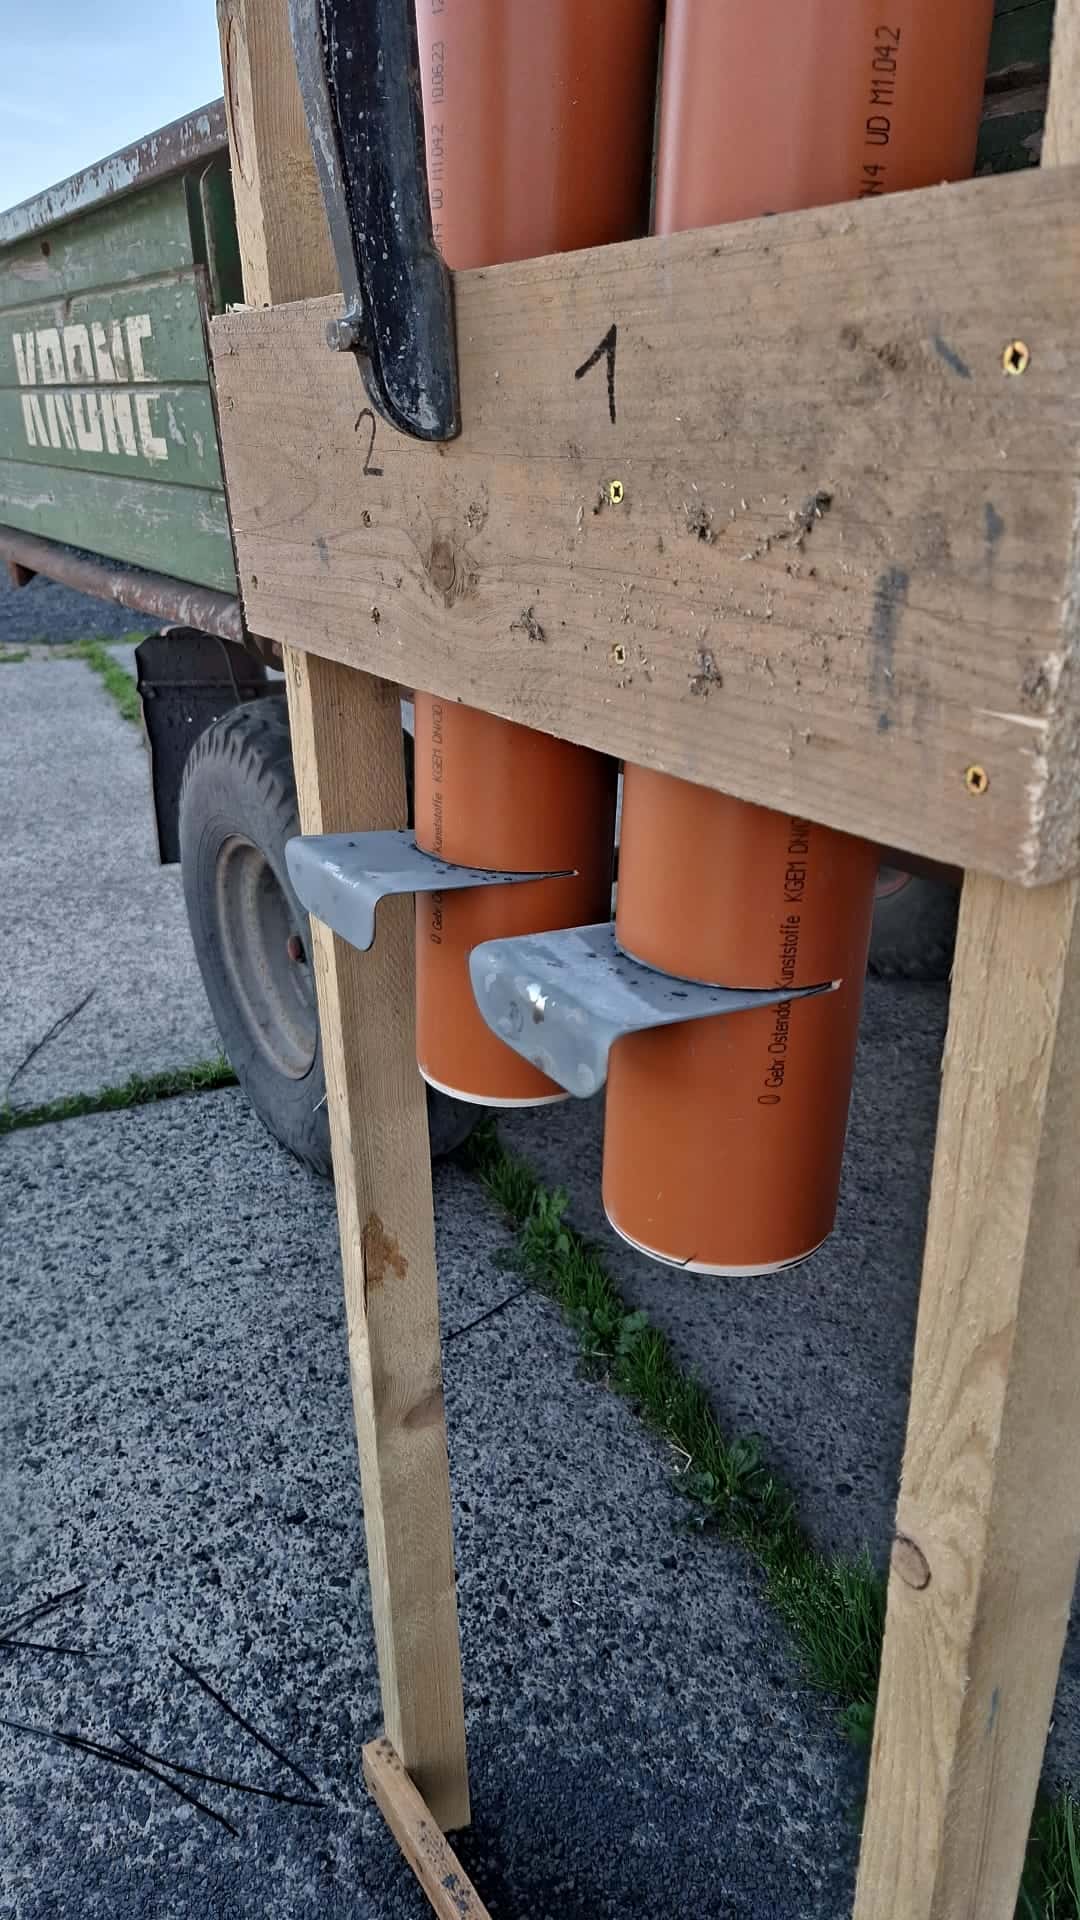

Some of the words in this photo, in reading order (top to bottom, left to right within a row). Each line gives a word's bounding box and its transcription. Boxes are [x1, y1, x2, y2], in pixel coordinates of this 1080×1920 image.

[865, 115, 892, 146] UD
[858, 163, 887, 199] N4
[574, 323, 617, 424] 1
[354, 407, 385, 477] 2
[784, 861, 807, 904] KGEM
